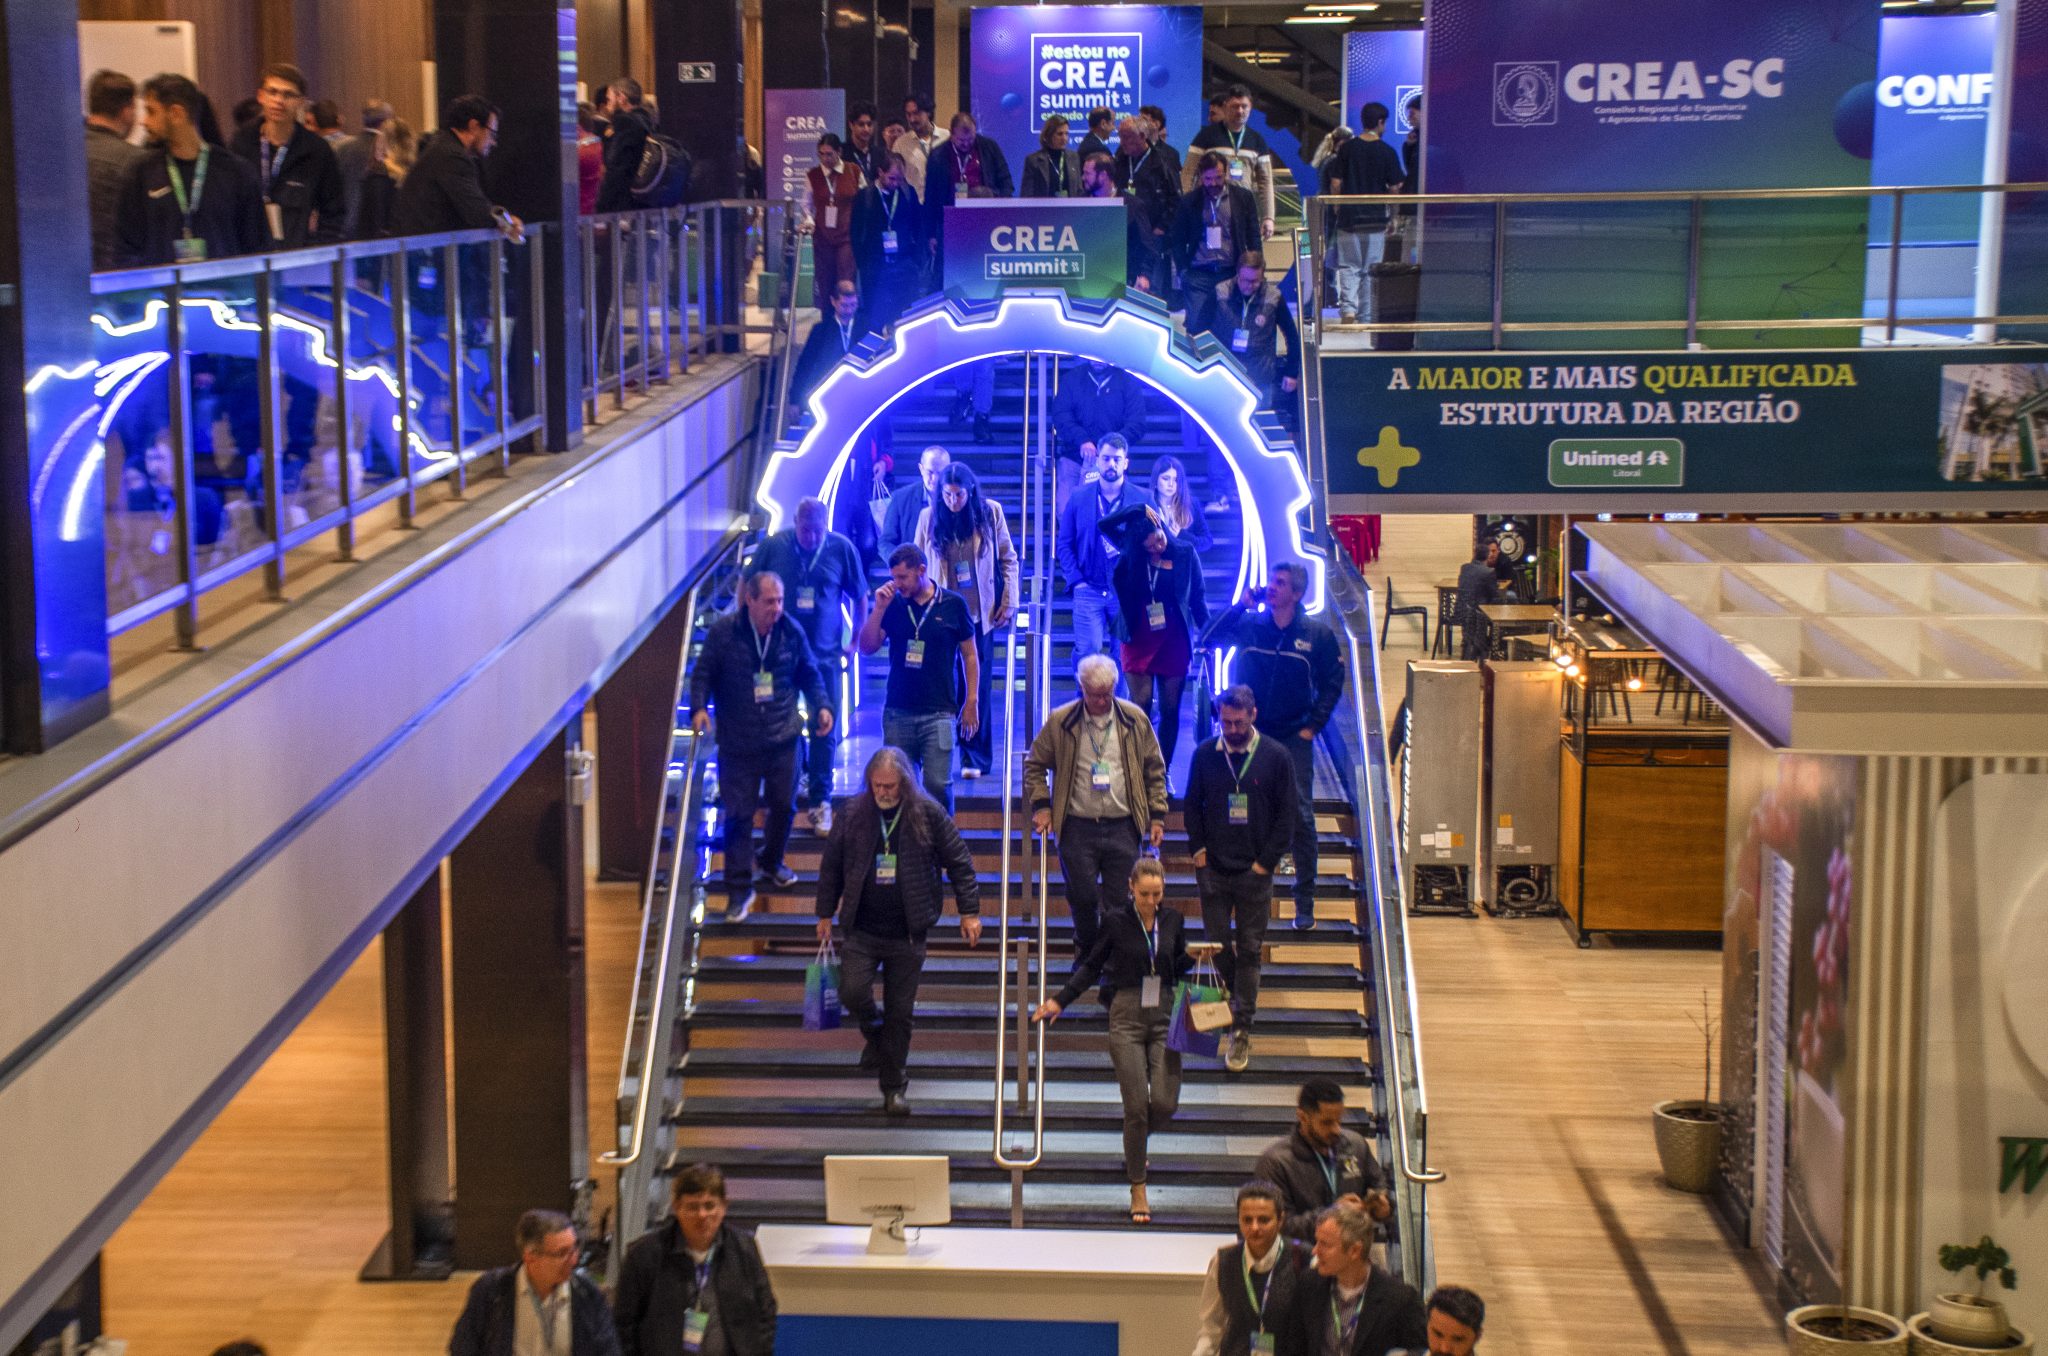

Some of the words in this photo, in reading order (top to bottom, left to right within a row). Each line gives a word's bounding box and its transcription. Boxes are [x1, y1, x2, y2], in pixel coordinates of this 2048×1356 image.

[1041, 45, 1103, 59] #estou
[1107, 46, 1130, 59] no
[1040, 61, 1131, 89] CREA
[1564, 58, 1785, 103] CREA-SC
[1876, 73, 1993, 107] CONF
[1040, 90, 1120, 109] summit
[1594, 106, 1635, 114] Conselho
[1638, 105, 1678, 116] Regional
[1681, 104, 1692, 112] de
[1695, 103, 1747, 113] Engenharia
[786, 116, 826, 129] CREA
[1608, 116, 1657, 125] Agronomia
[1673, 114, 1700, 122] Santa
[1702, 113, 1743, 121] Catarina
[990, 225, 1079, 252] CREA
[991, 258, 1068, 275] summit
[1387, 368, 1411, 390] A
[1417, 367, 1523, 390] MAIOR
[1528, 367, 1548, 389] E
[1553, 366, 1637, 389] MAIS
[1643, 364, 1857, 394] QUALIFICADA
[1440, 402, 1626, 425] ESTRUTURA
[1631, 401, 1676, 424] DA
[1681, 393, 1800, 424] REGIÃO
[1563, 450, 1642, 466] Unimed
[1613, 469, 1641, 477] Litoral
